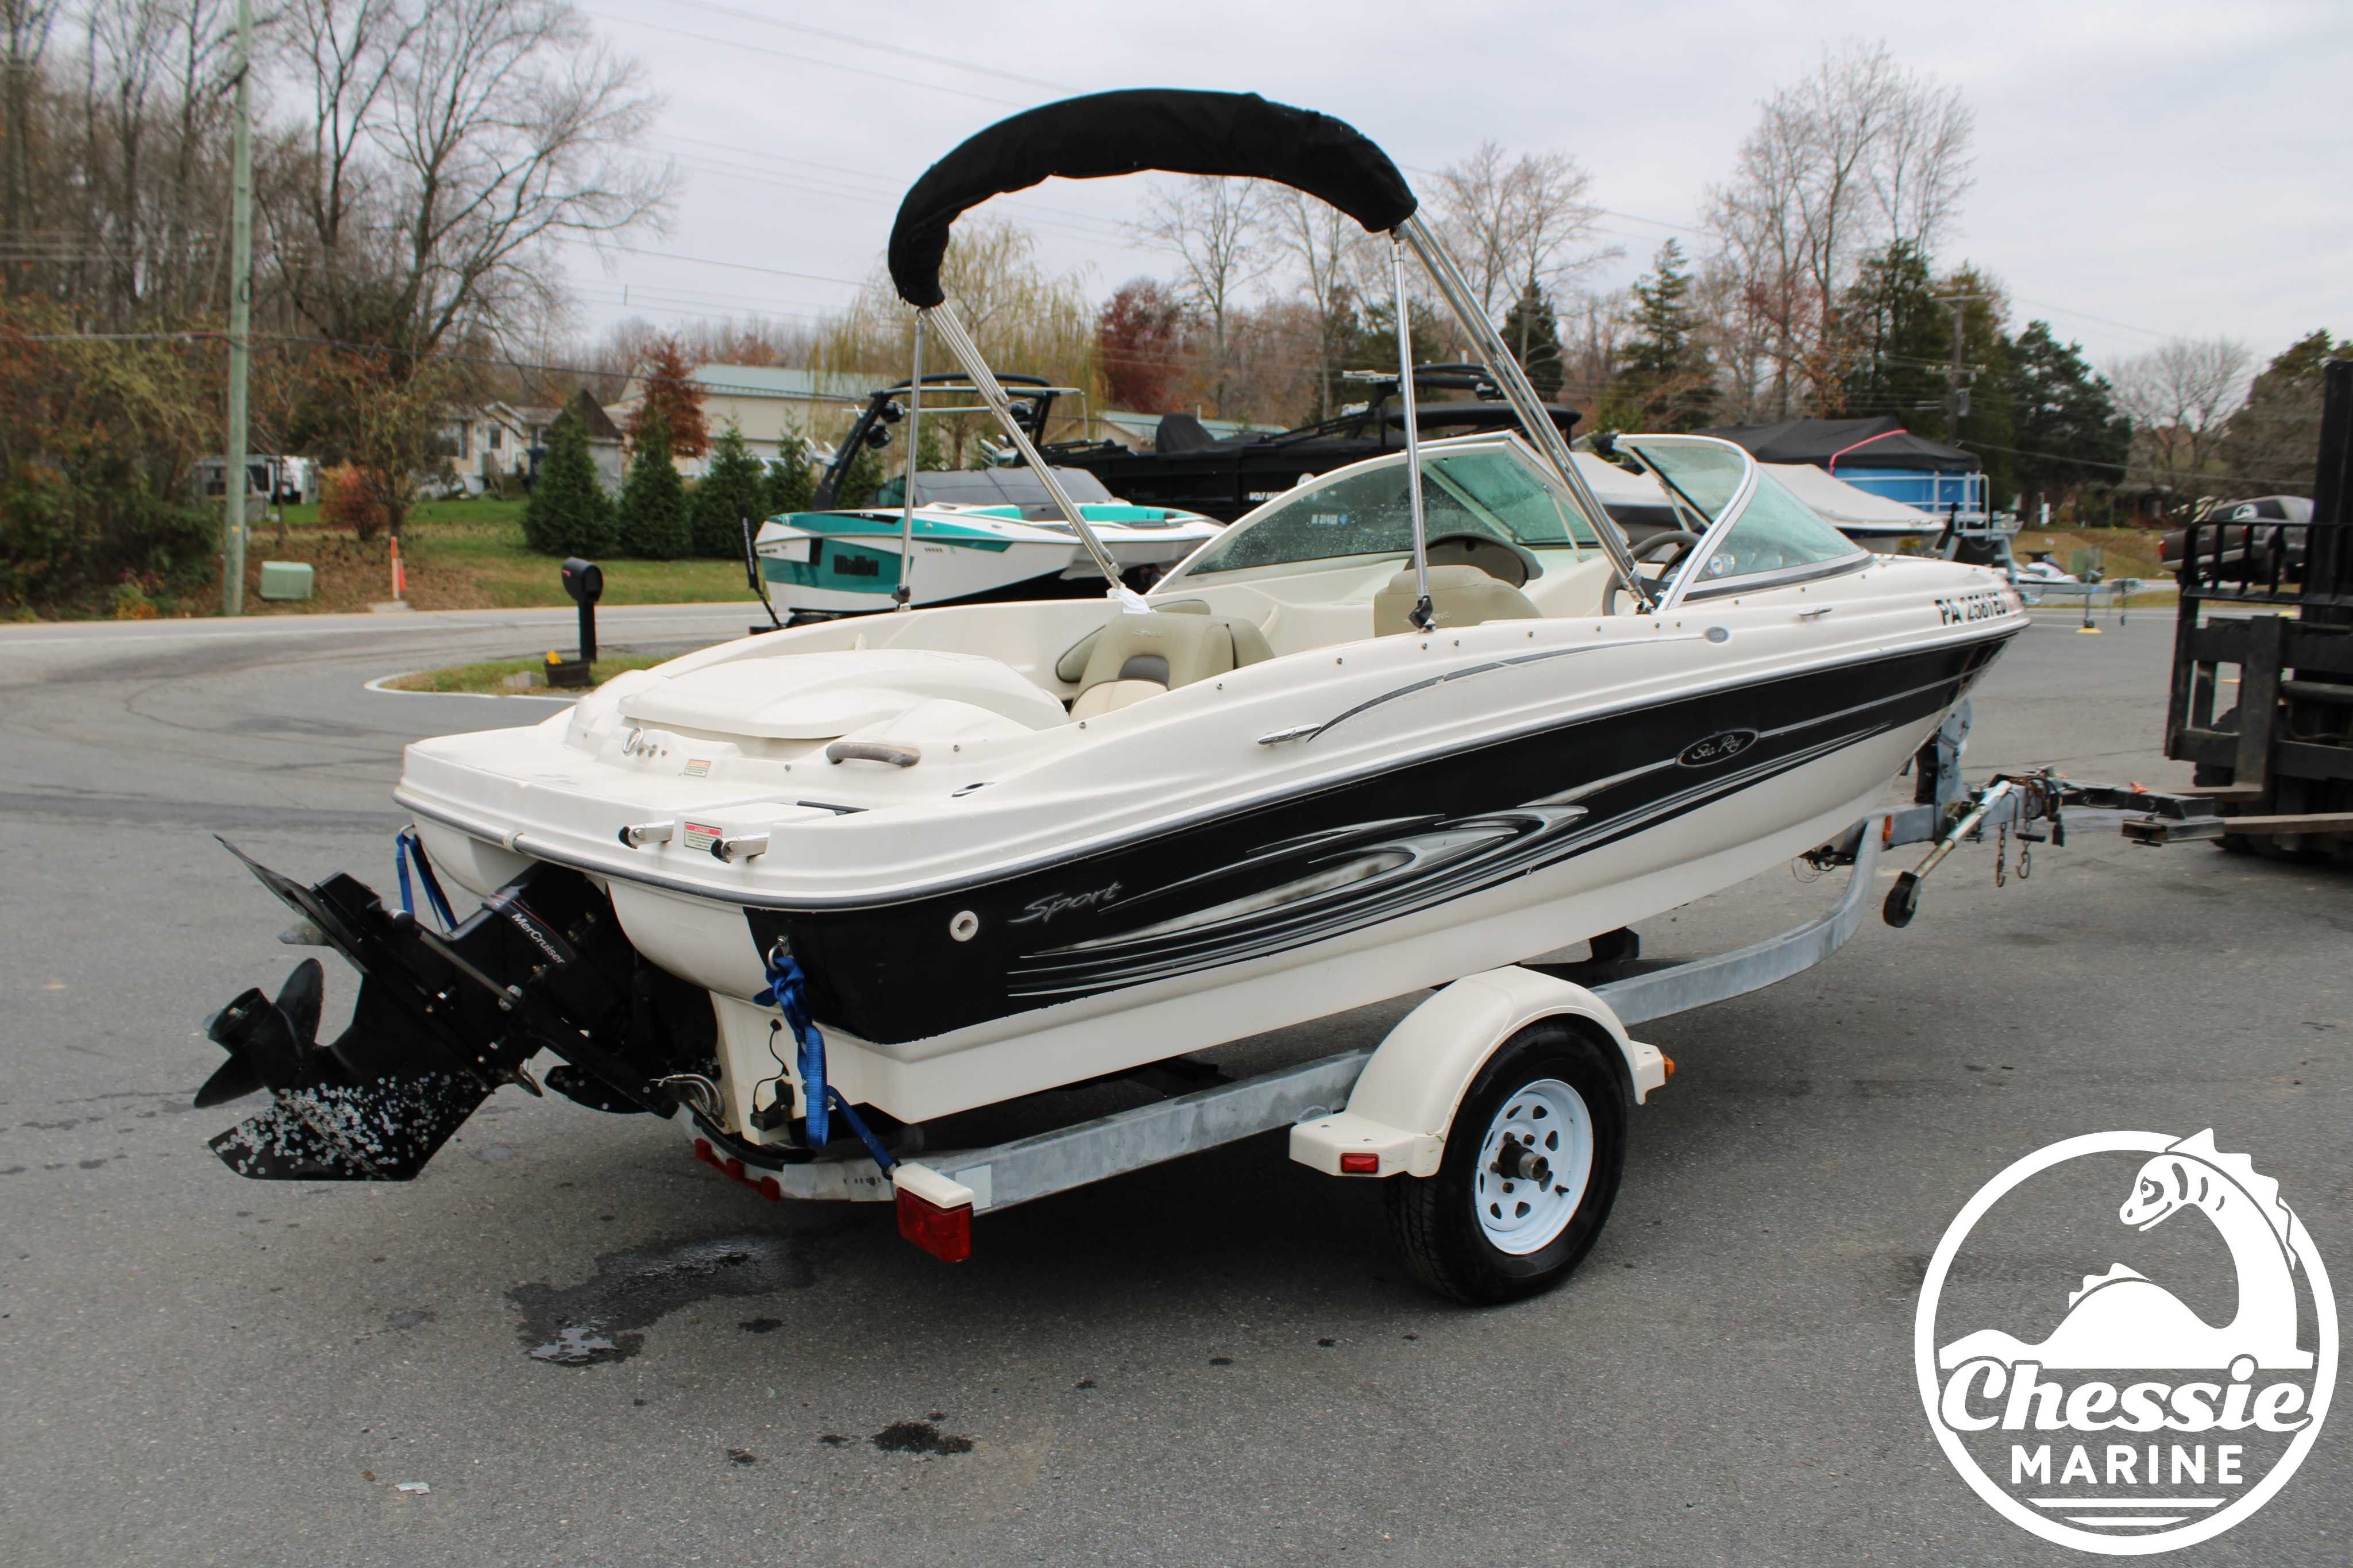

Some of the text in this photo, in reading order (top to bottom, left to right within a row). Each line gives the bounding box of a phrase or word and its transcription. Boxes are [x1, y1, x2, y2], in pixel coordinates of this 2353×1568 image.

[1934, 598, 1964, 625] PA
[1692, 735, 1743, 759] Sea Ray
[1006, 881, 1123, 923] Sport
[511, 913, 565, 963] MerCruiser
